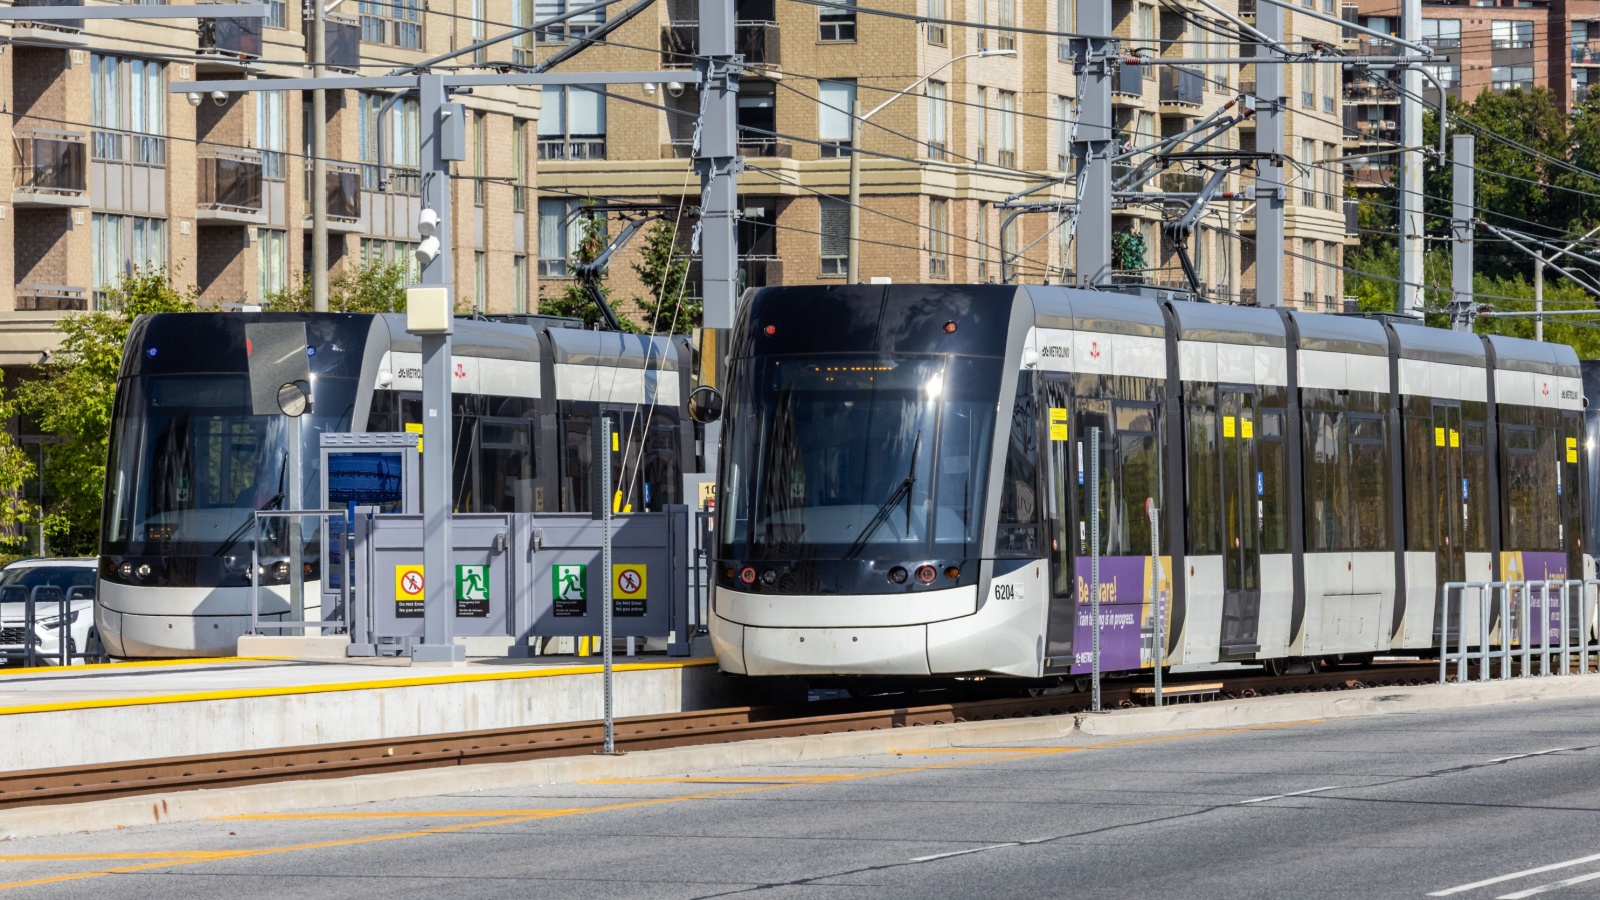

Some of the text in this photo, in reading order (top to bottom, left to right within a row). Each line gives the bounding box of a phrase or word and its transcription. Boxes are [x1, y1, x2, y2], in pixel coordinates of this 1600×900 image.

[994, 584, 1014, 601] 6204
[1078, 575, 1089, 603] Be
[1077, 610, 1088, 626] Train
[1104, 610, 1110, 626] is
[1109, 610, 1114, 626] in
[1113, 613, 1135, 630] progress.
